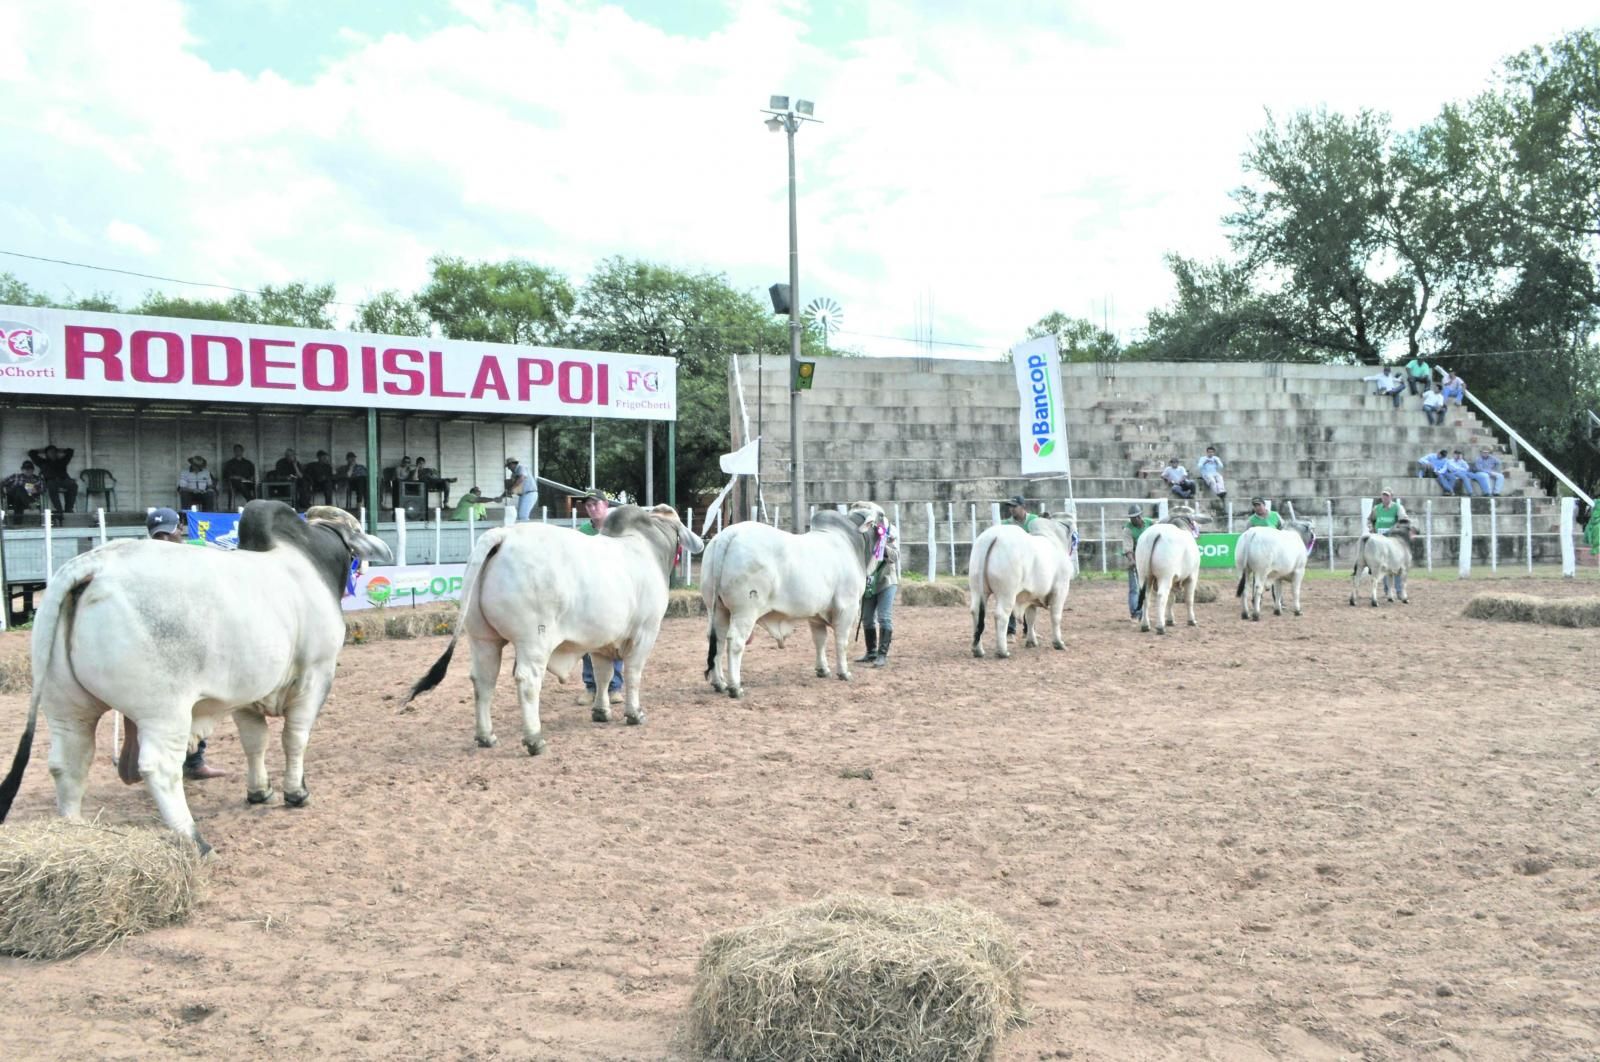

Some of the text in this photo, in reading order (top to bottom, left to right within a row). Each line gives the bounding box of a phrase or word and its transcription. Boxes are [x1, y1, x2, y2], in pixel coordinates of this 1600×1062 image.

[65, 325, 349, 392] RODEO
[616, 400, 672, 411] FrigoChorti
[1028, 354, 1050, 436] Bancop
